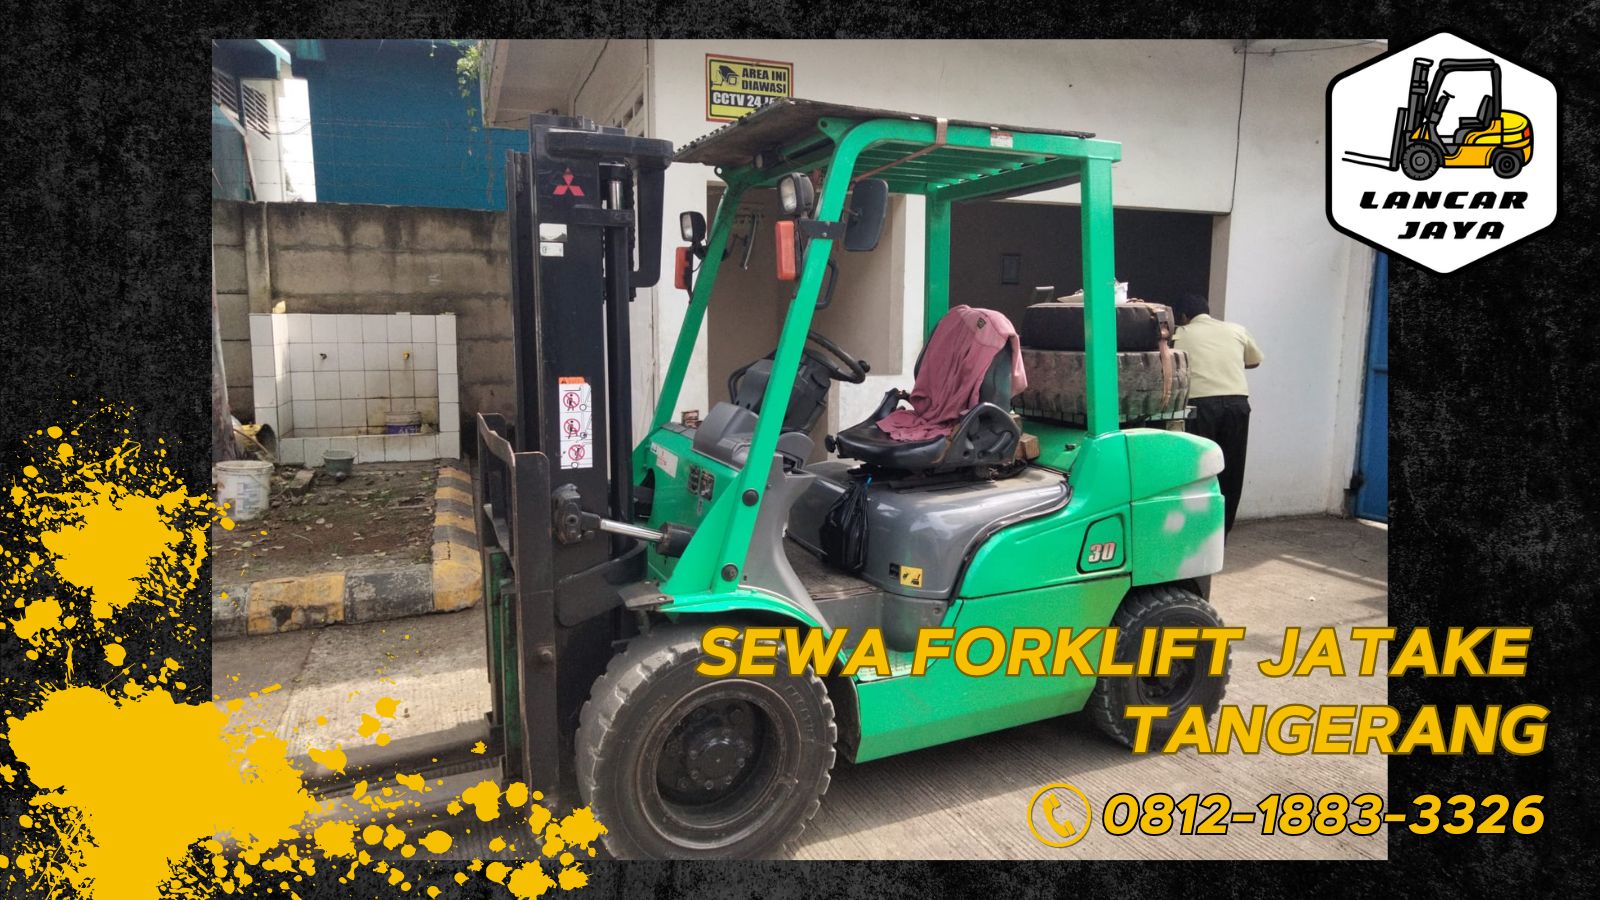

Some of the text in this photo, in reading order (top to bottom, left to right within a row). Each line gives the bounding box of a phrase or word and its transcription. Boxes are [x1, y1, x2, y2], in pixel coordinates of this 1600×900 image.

[741, 68, 787, 82] AREA INI
[741, 80, 787, 94] DIAWASI
[712, 92, 745, 106] CCTV
[747, 95, 762, 107] 24
[1087, 541, 1117, 565] 30
